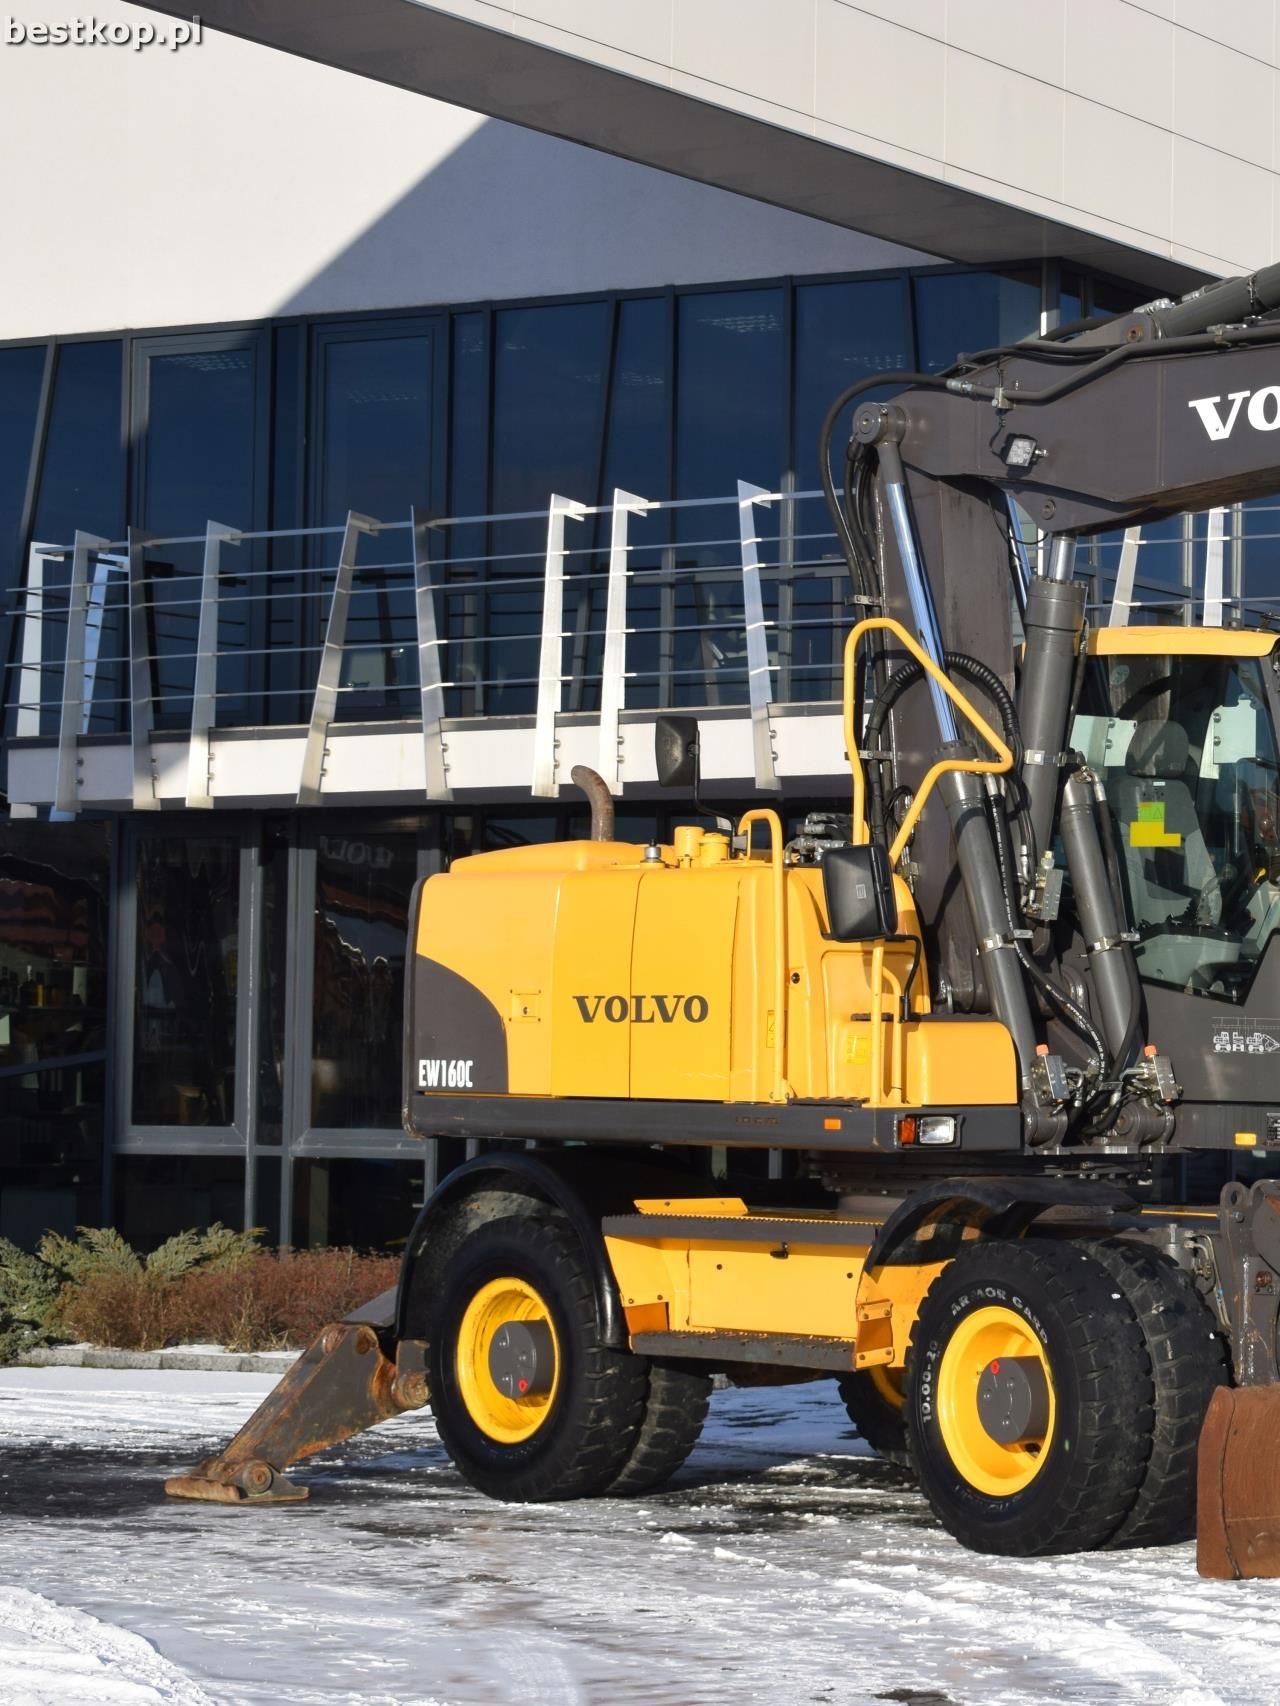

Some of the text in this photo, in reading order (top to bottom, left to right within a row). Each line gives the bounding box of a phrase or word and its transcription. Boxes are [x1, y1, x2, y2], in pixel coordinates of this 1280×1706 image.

[572, 995, 709, 1023] VOLVO
[418, 1059, 474, 1088] EW160C
[951, 1286, 1049, 1345] ARMOR GARD
